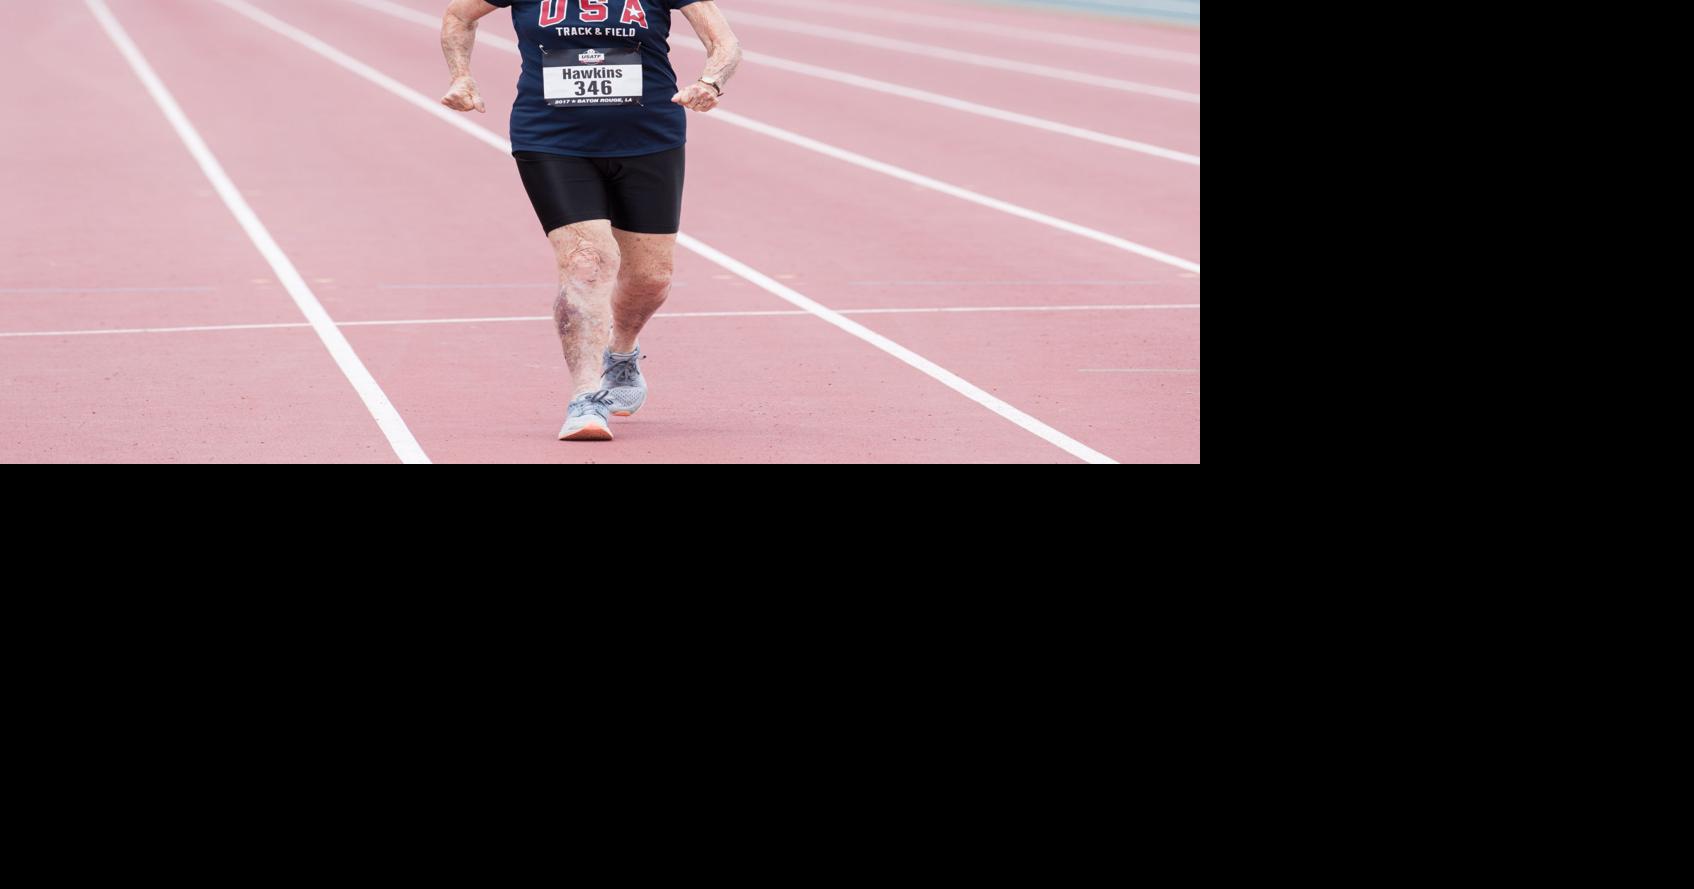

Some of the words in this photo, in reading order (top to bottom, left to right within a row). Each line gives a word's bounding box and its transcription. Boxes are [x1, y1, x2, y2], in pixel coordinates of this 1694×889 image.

[538, 0, 649, 29] USA
[555, 27, 593, 37] TRACK
[594, 27, 602, 36] &
[605, 27, 636, 37] FIELD
[562, 67, 623, 80] Hawkins
[574, 80, 613, 96] 346
